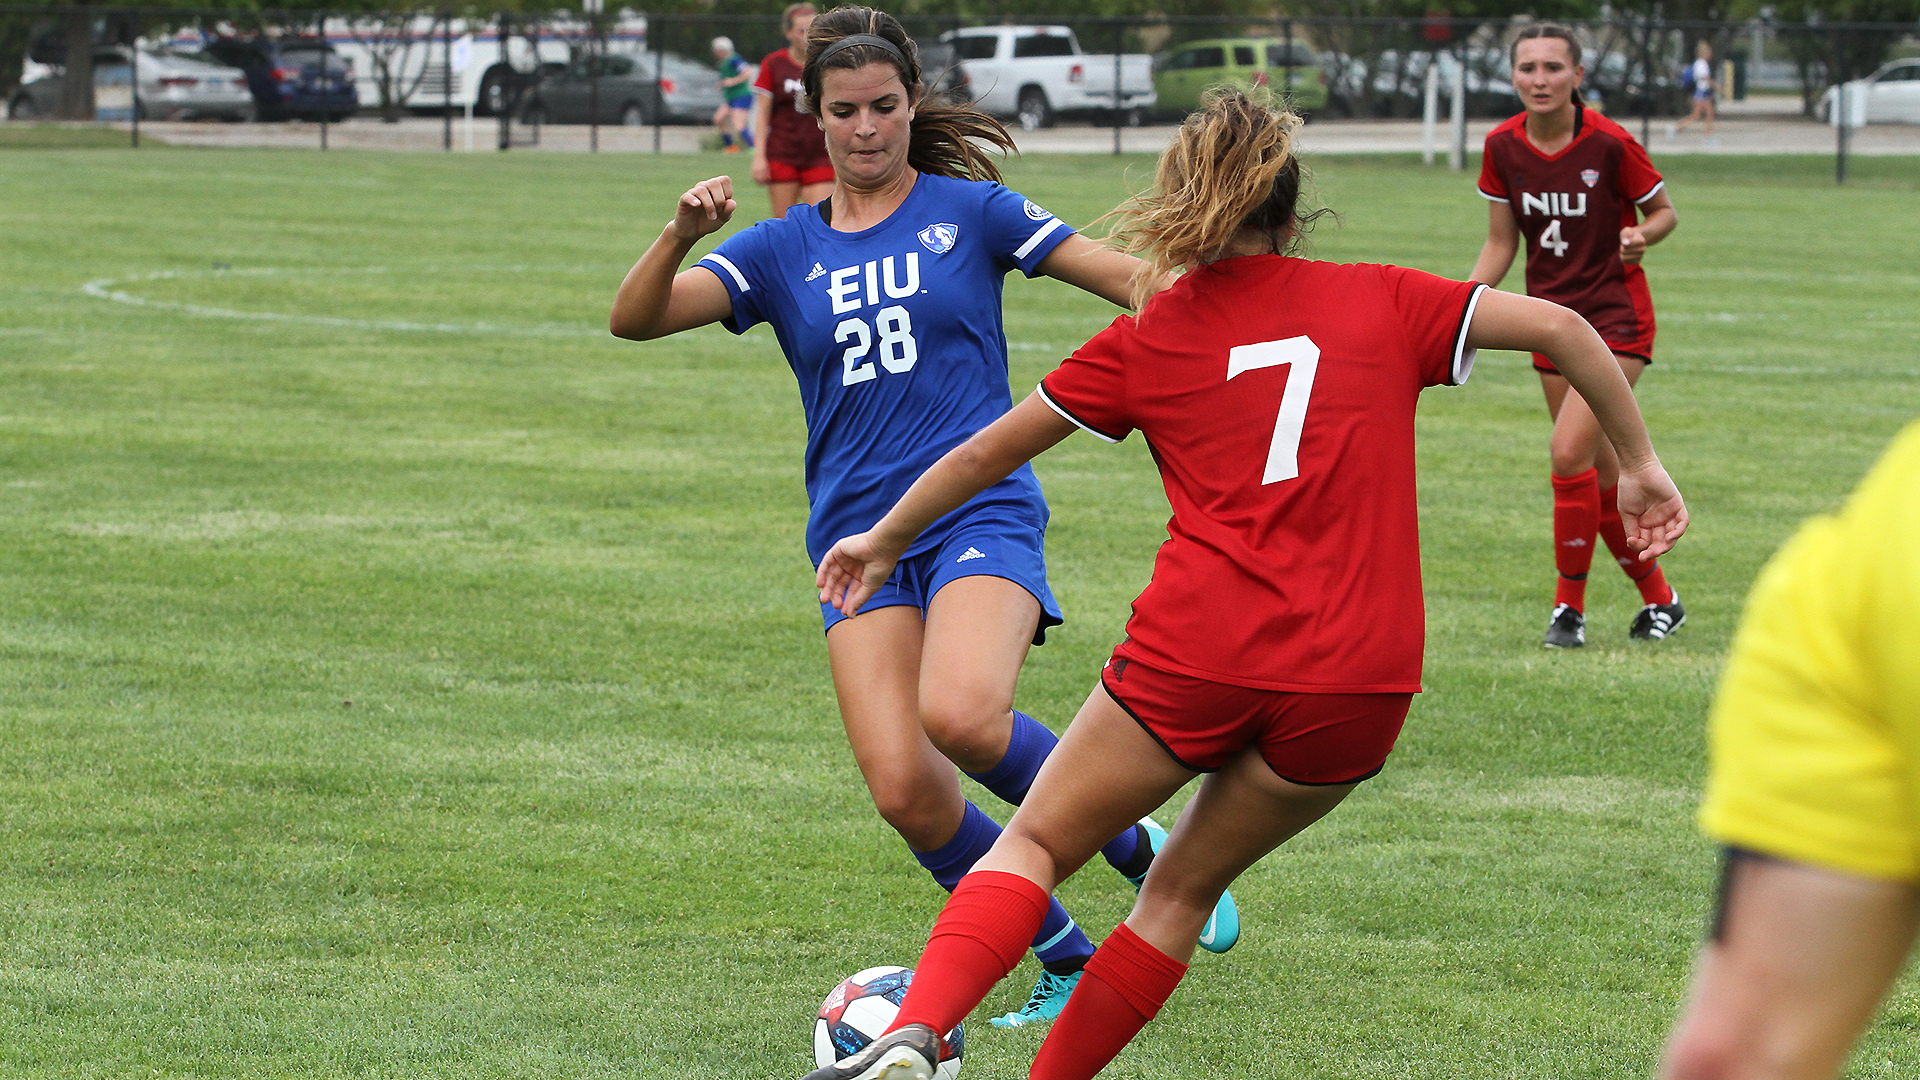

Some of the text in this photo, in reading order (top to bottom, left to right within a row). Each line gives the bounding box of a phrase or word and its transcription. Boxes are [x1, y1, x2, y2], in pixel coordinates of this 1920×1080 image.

[1522, 192, 1587, 217] NIU
[1540, 219, 1569, 257] 4
[826, 252, 920, 315] EIU
[834, 304, 918, 387] 28
[1226, 334, 1322, 486] 7
